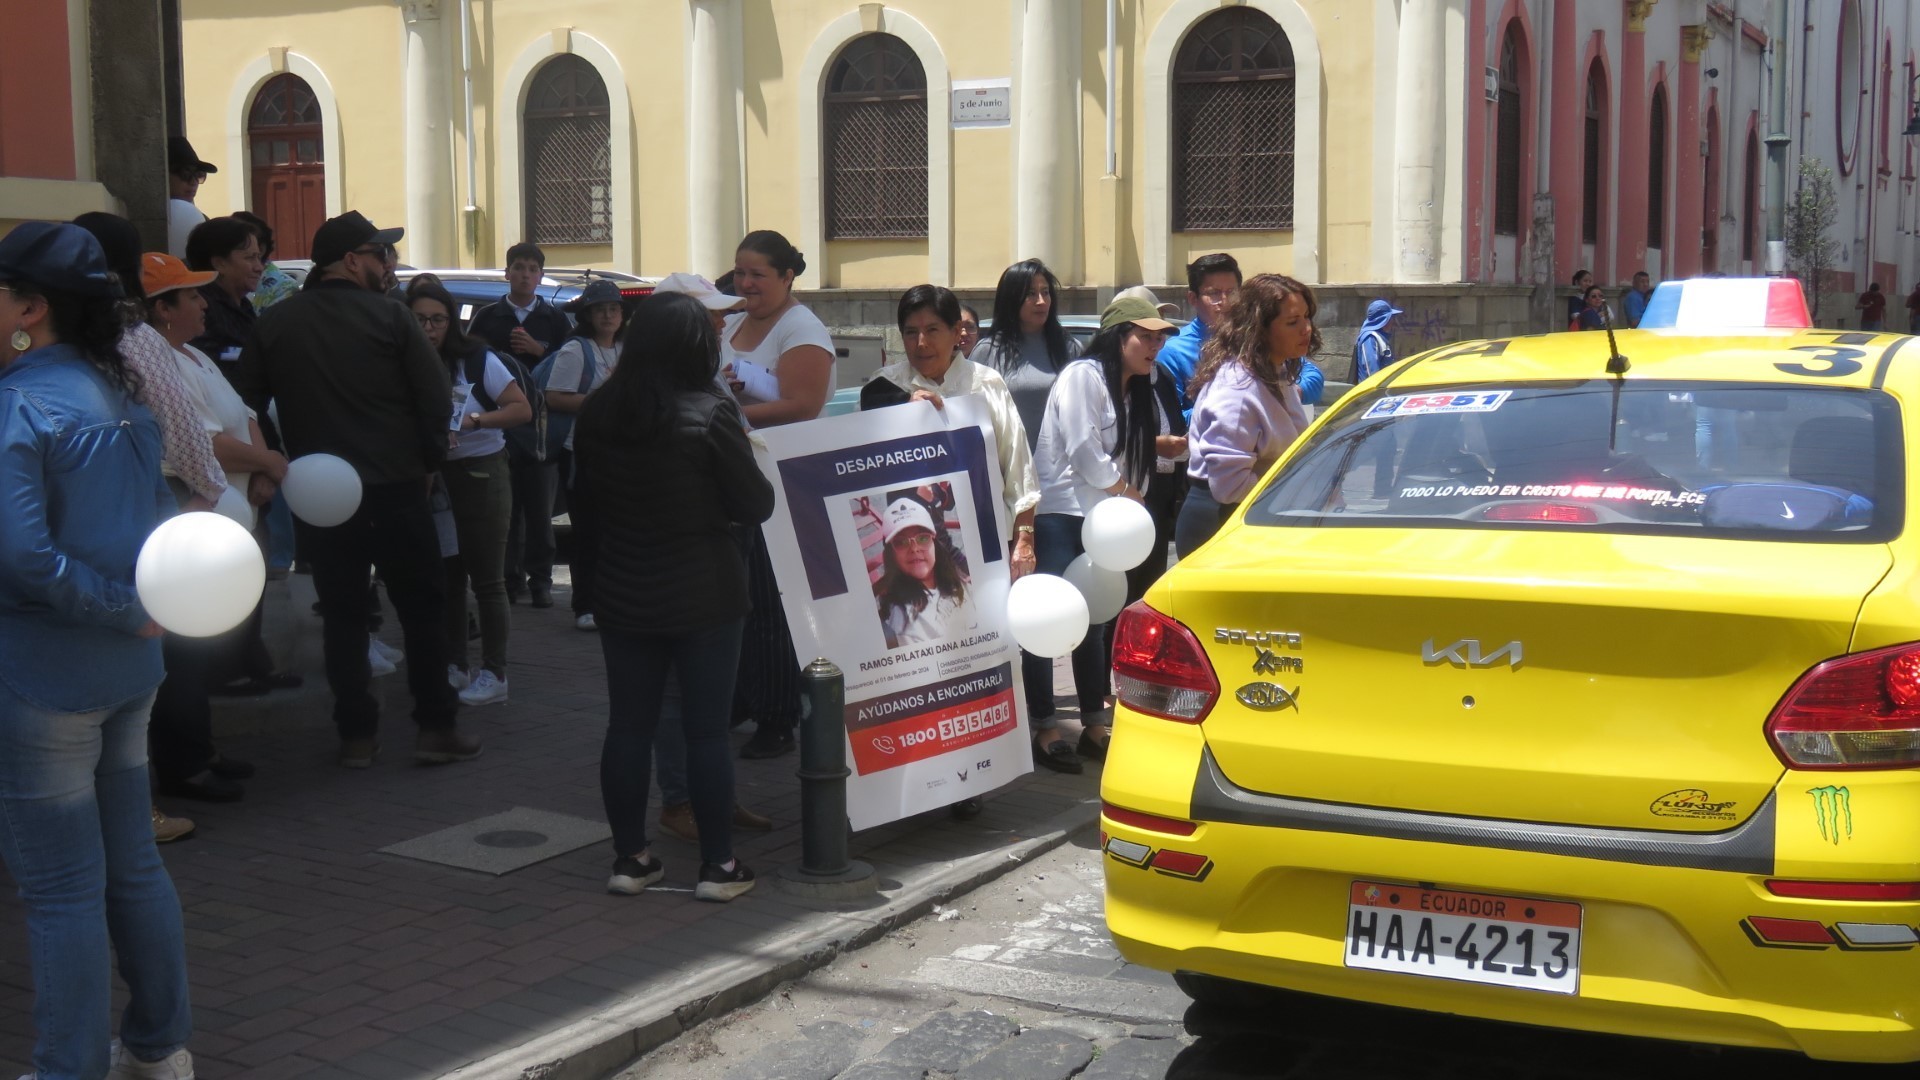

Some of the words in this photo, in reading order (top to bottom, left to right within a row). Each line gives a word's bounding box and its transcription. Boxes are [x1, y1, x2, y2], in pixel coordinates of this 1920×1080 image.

[978, 99, 1003, 107] Junio
[1773, 346, 1867, 377] 3
[1402, 394, 1501, 408] 5351
[834, 444, 948, 476] DESAPARECIDA
[1400, 487, 1435, 498] TODO
[1434, 486, 1453, 497] LO
[1499, 485, 1521, 496] EN
[1521, 485, 1572, 497] CRISTO
[1214, 628, 1301, 643] SOLUTO
[859, 657, 894, 672] RAMOS
[895, 646, 934, 664] PILATAXI
[936, 640, 959, 655] DANA
[960, 631, 999, 648] ALEJANDRA
[1422, 638, 1522, 666] KIA
[894, 671, 911, 679] febrero
[917, 666, 929, 674] 2024
[858, 694, 924, 721] AYÚDANOS
[927, 691, 936, 704] A
[937, 673, 1003, 701] ENCONTRARLA
[898, 727, 937, 748] 1800
[976, 759, 991, 771] FGE
[1420, 893, 1506, 918] ECUADOR
[1350, 910, 1570, 979] HAA-4213
